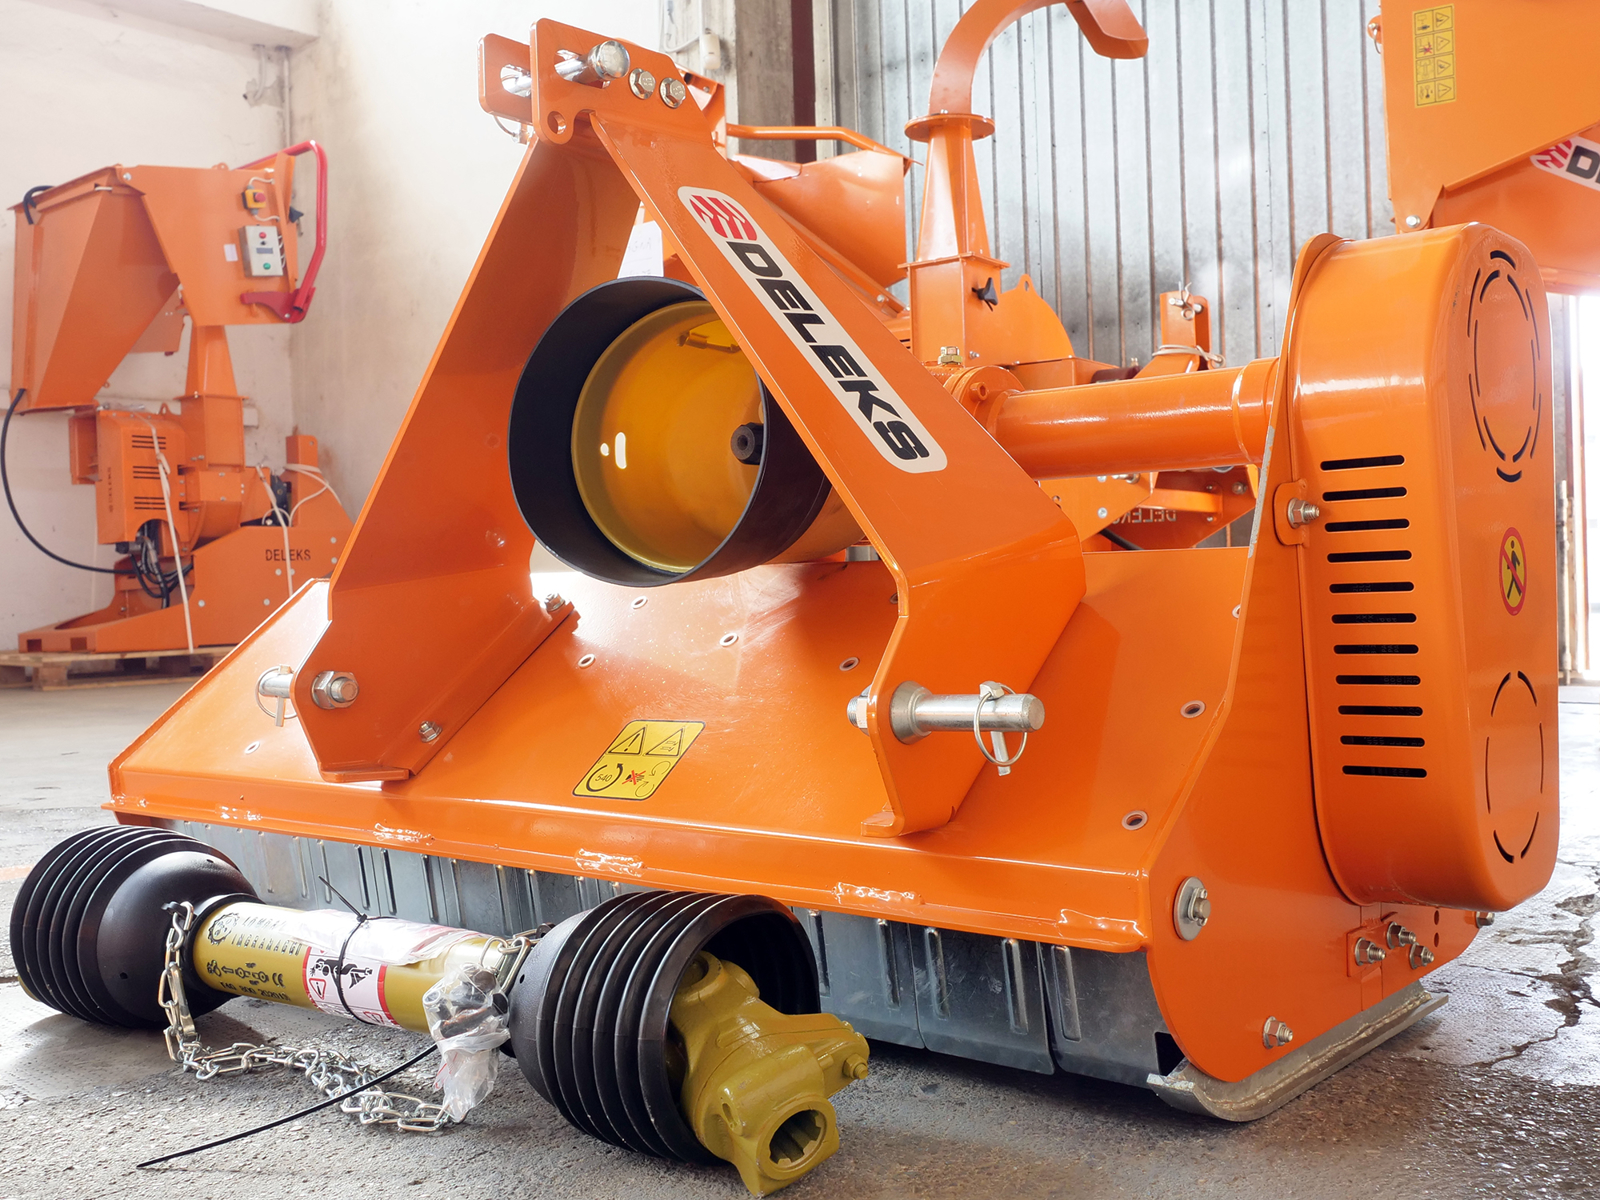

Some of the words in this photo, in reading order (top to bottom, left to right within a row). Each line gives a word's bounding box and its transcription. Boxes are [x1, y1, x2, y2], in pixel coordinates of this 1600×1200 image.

[1566, 145, 1600, 185] D
[725, 240, 930, 460] DELEKS
[265, 549, 311, 561] DELEKS
[595, 773, 613, 782] 540
